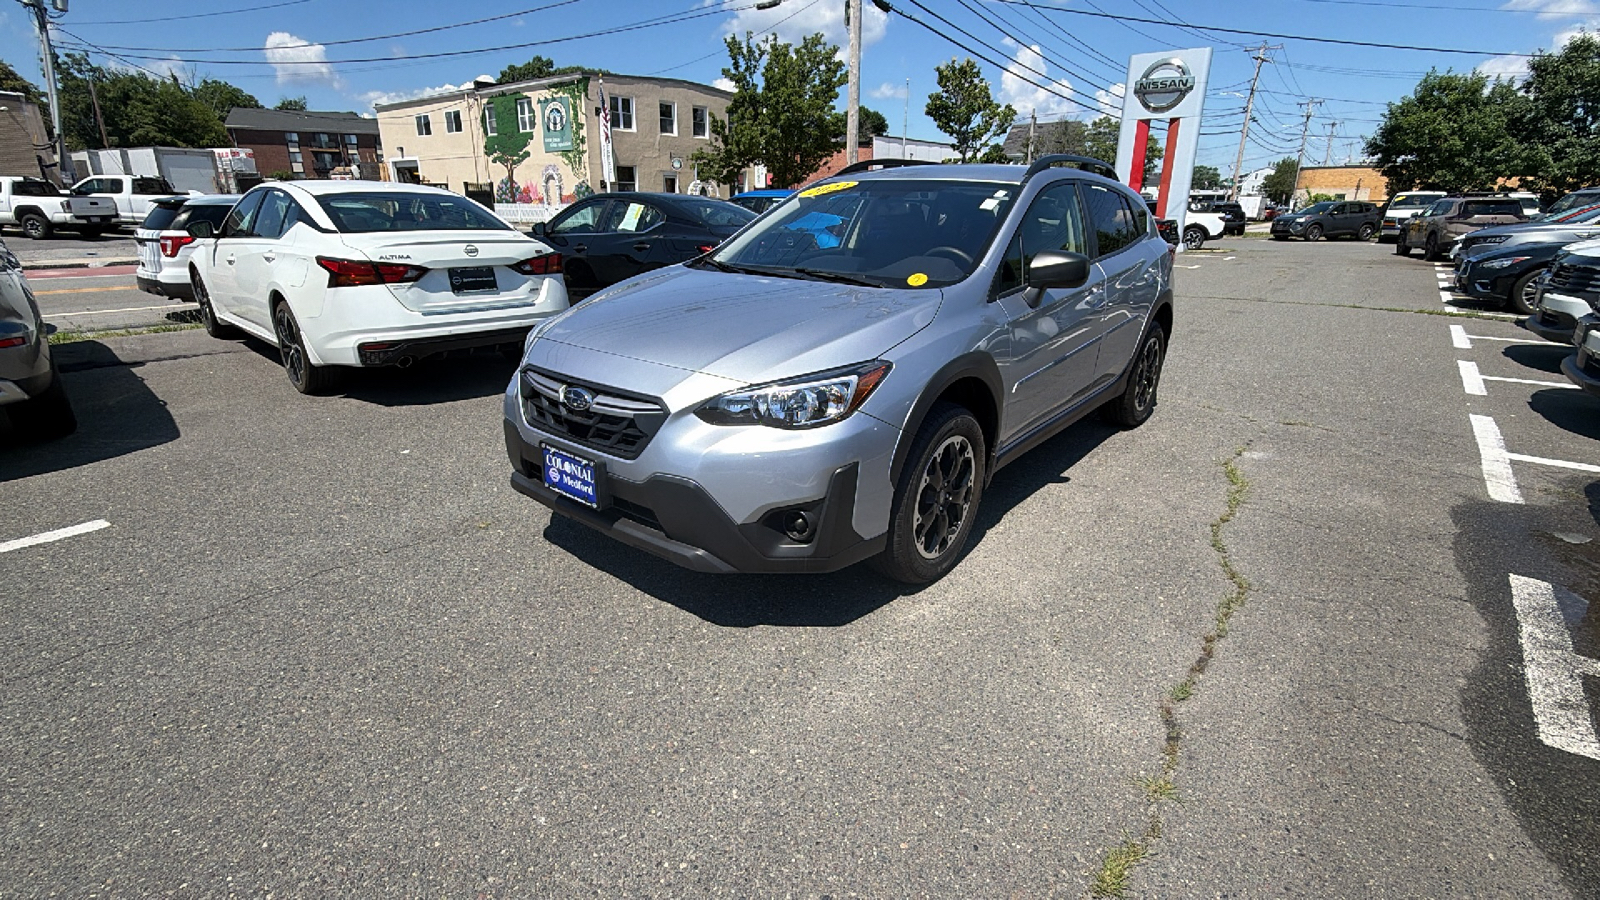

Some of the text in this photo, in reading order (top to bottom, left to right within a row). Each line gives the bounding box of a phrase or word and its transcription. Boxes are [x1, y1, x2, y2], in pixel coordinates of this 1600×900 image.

[1139, 78, 1189, 91] NISSAN
[546, 454, 594, 483] COLONIAL
[563, 474, 593, 496] Medford
